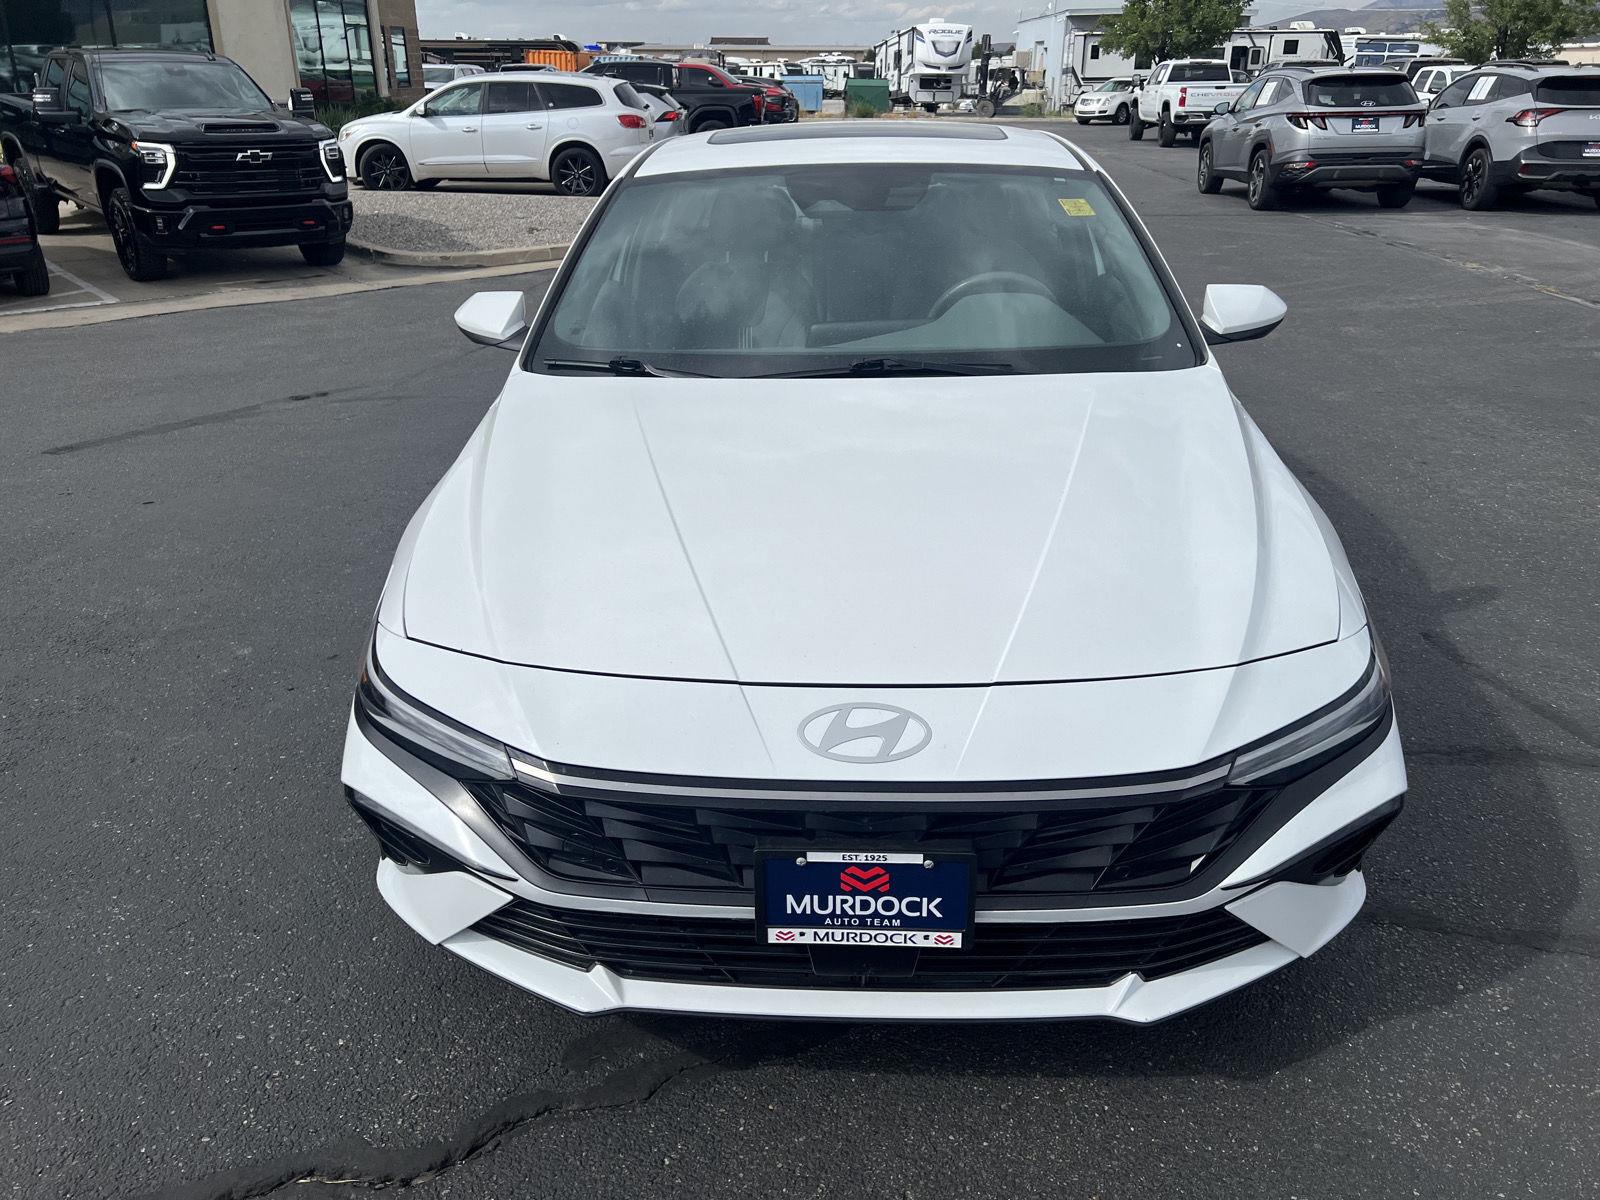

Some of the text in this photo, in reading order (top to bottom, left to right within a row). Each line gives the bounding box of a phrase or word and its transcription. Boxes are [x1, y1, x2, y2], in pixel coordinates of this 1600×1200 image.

[863, 854, 888, 862] 1925
[786, 894, 943, 918] MURDOCK
[824, 917, 901, 927] AUTO TEAM
[813, 931, 918, 945] MURDOCK
